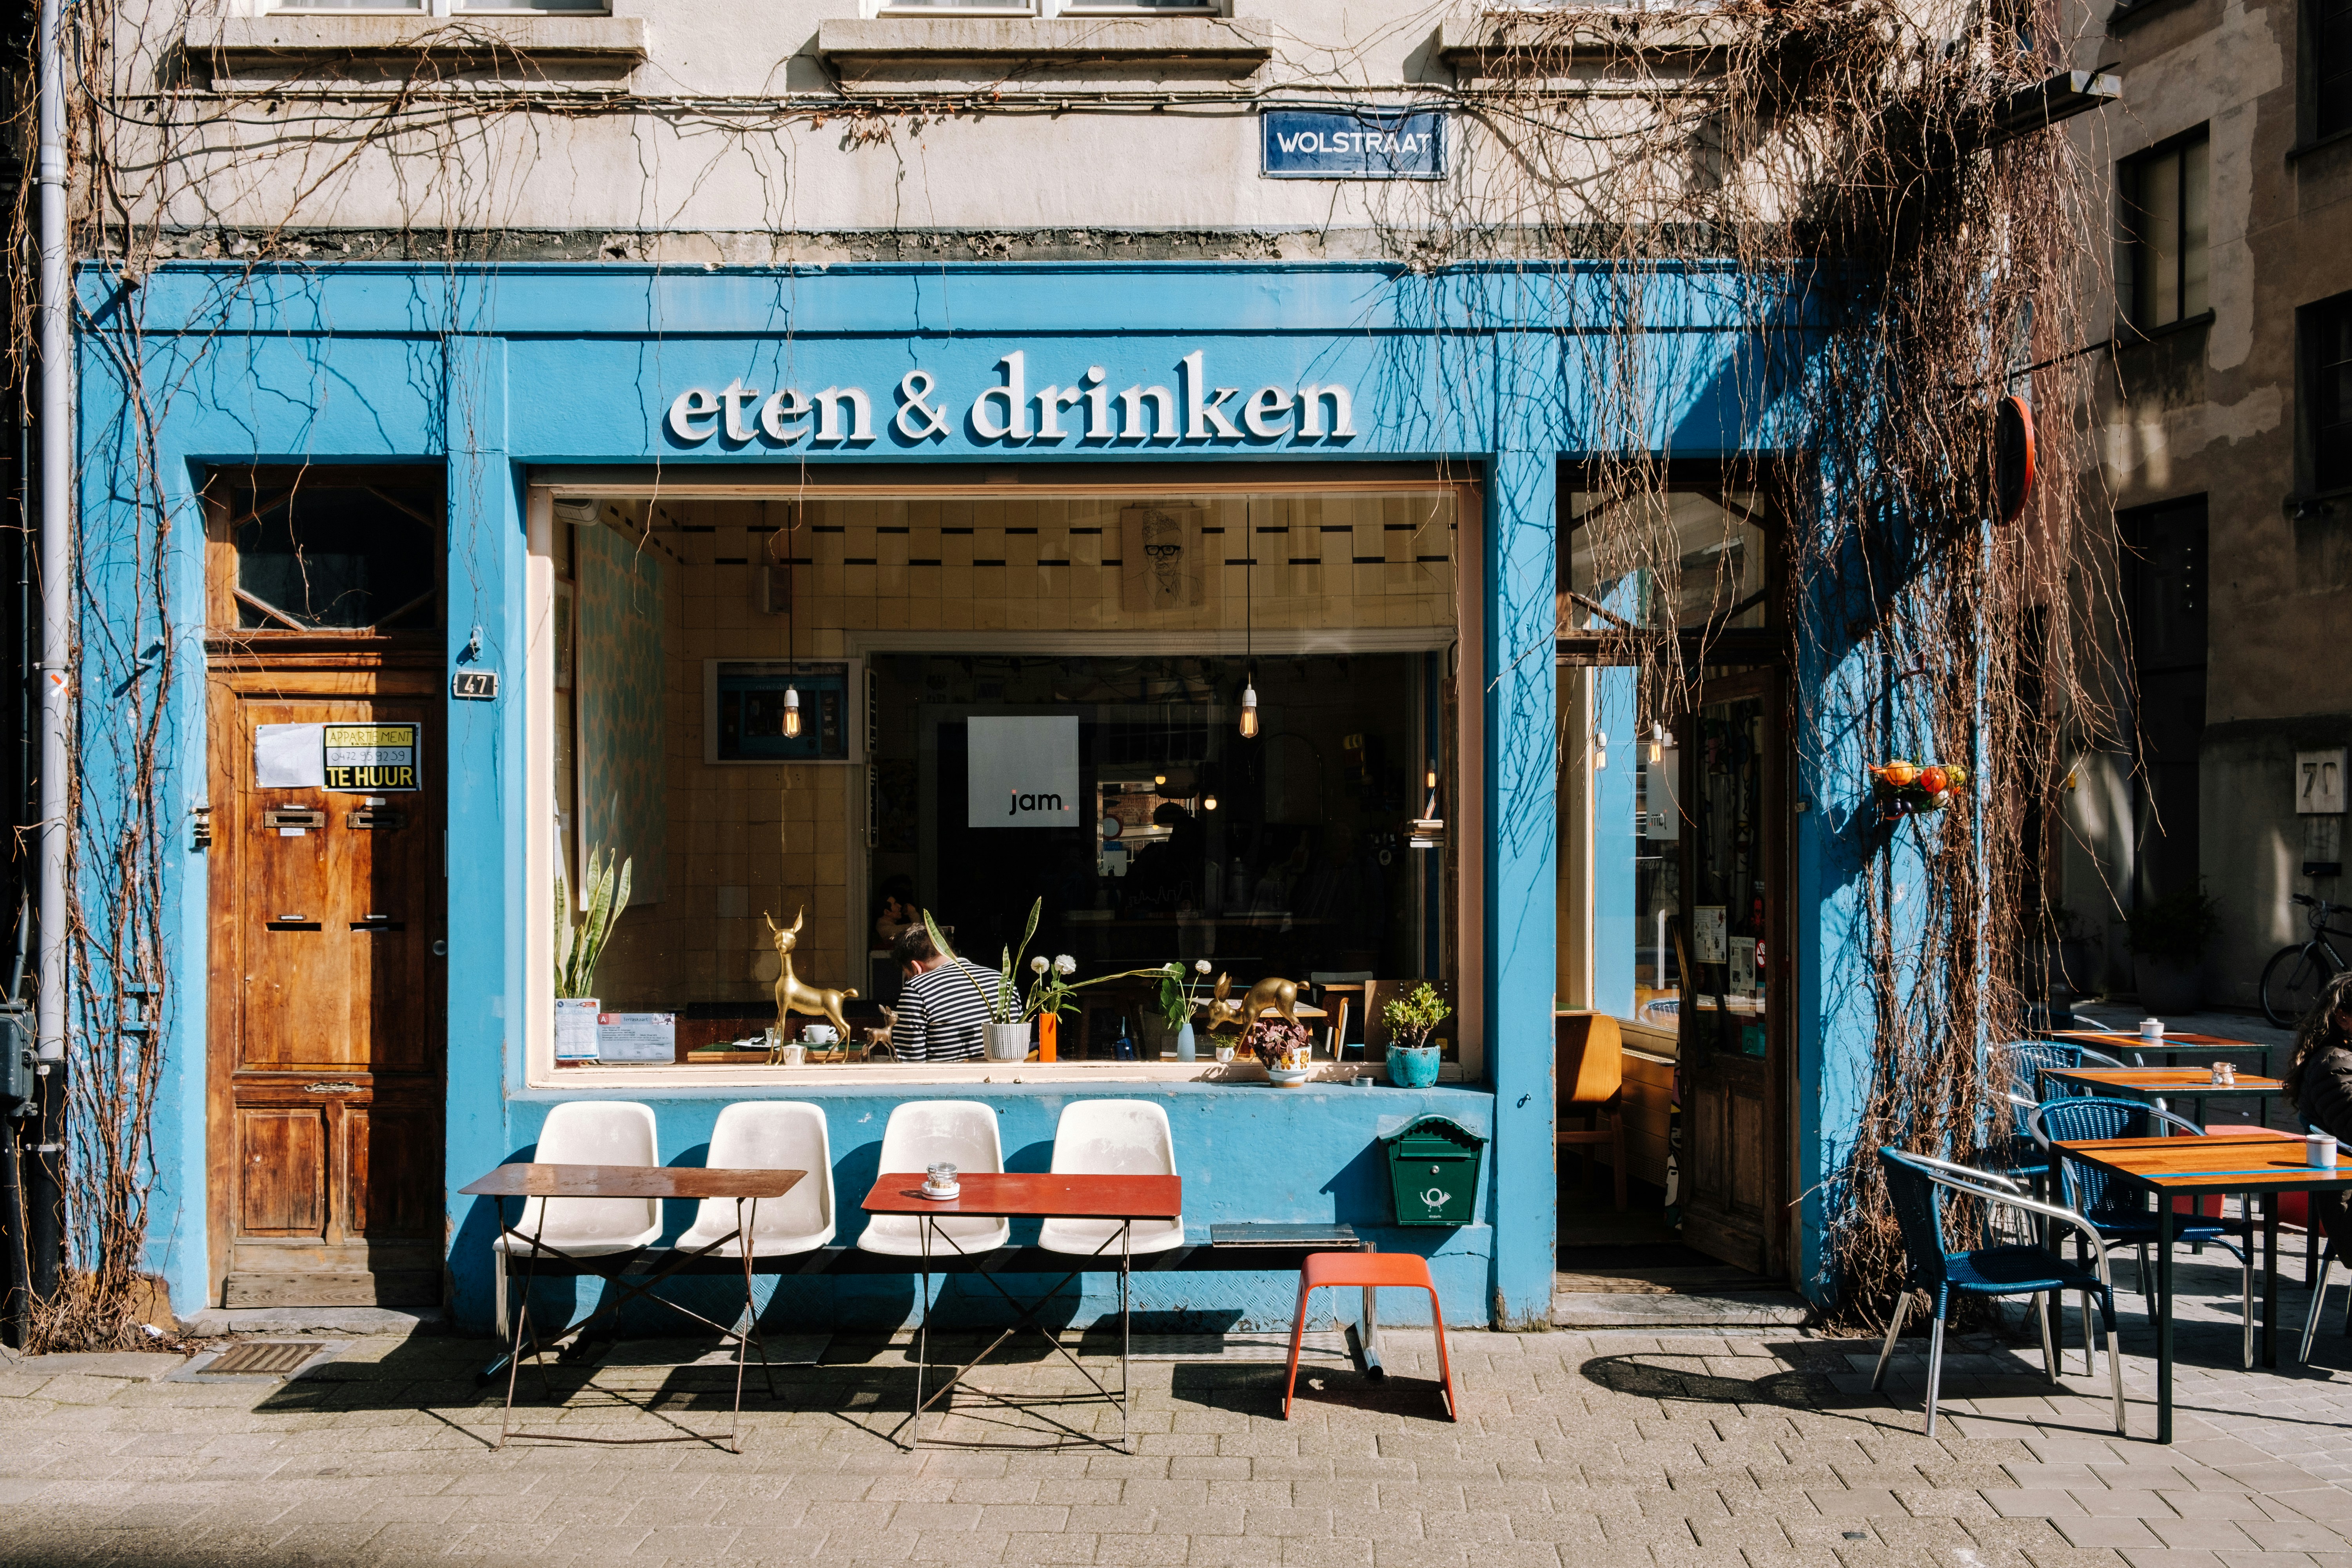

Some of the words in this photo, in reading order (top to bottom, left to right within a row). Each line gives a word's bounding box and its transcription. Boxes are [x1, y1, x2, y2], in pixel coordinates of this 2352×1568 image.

[1277, 131, 1432, 153] WOLSTRAAT
[669, 376, 877, 441] eten
[896, 369, 952, 440] &
[971, 349, 1357, 439] drinken
[464, 675, 487, 694] 47
[330, 731, 412, 743] APPARTEMENT
[331, 751, 356, 761] 0472
[360, 751, 373, 761] 95
[376, 751, 388, 761] 92
[391, 751, 405, 761] 59
[326, 767, 351, 786] TE
[355, 767, 413, 786] HUUR
[1009, 789, 1069, 816] jam.
